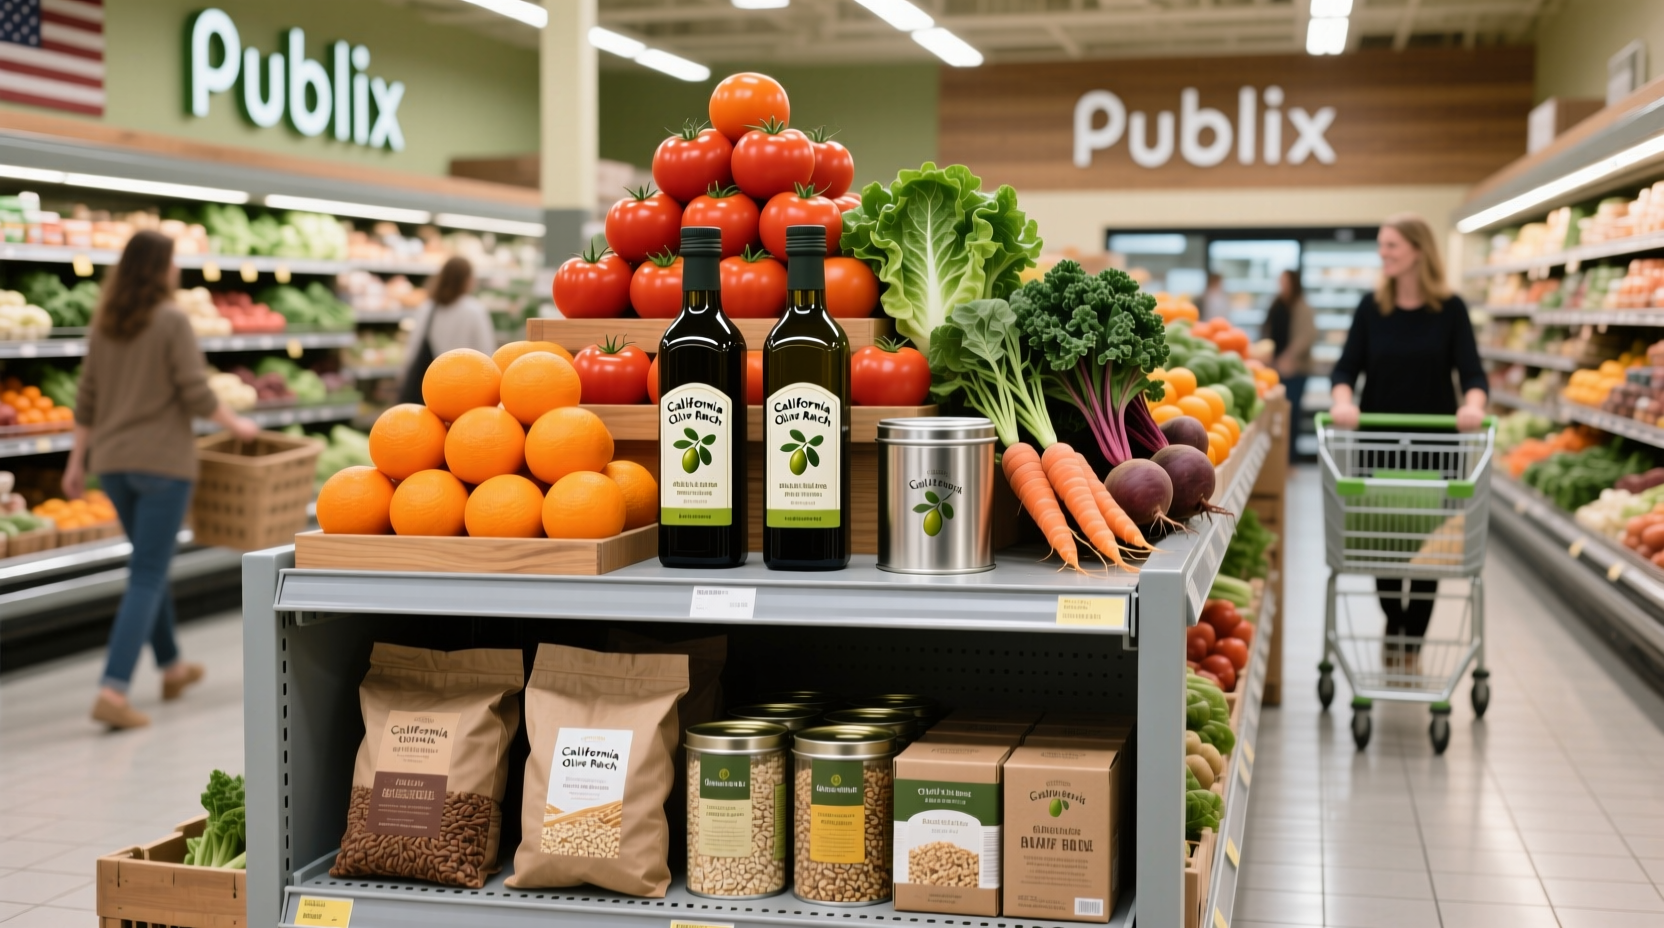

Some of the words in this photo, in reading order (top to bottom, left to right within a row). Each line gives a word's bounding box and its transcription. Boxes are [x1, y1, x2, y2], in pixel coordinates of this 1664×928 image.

[190, 7, 405, 153] Publix
[1072, 84, 1338, 170] Publix
[774, 397, 831, 415] California
[561, 746, 619, 761] California
